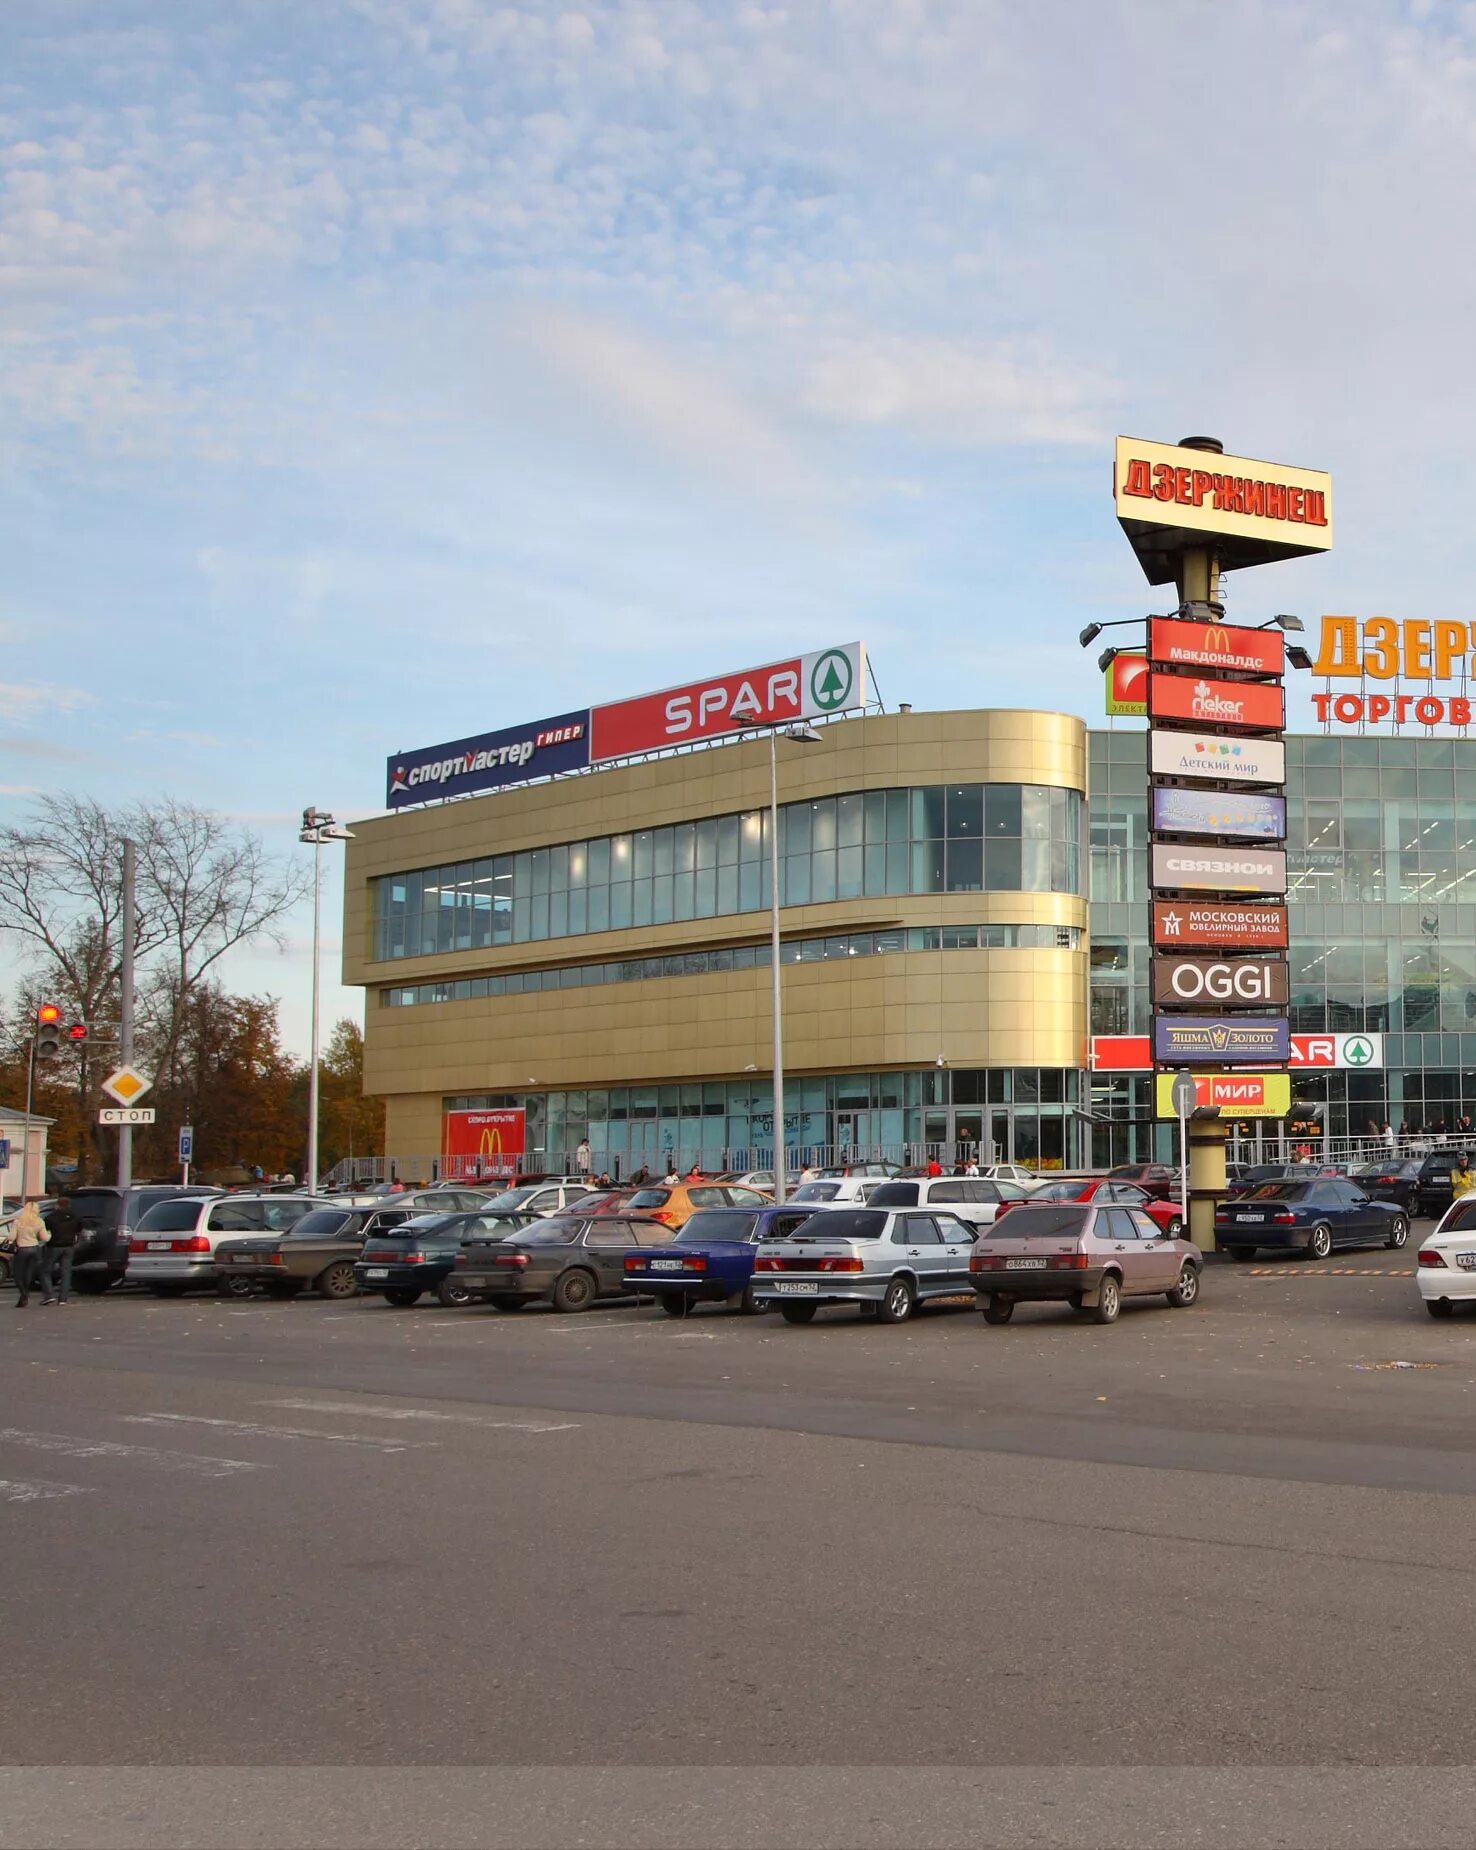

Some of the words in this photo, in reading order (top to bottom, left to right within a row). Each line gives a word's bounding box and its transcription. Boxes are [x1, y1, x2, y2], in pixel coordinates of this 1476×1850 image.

[1123, 459, 1328, 526] ДЗЕРЖИНЕЦ
[1170, 647, 1264, 669] Макдоналдс
[665, 670, 798, 734] SPAR
[1112, 704, 1145, 714] ЭЛЕКТ
[1192, 694, 1244, 713] rieker
[537, 724, 583, 746] ГИПЕР
[1179, 755, 1229, 772] Детский
[1234, 761, 1258, 776] мир
[1189, 911, 1280, 924] МОСКОВСКИЙ
[1189, 923, 1248, 932] ЮВЕЛИРНЫЙ
[1250, 924, 1281, 933] ЗАВОД
[1171, 963, 1271, 999] OGGI
[1172, 1032, 1209, 1043] ЯШМА
[1231, 1032, 1274, 1043] ЗОЛОТО
[1215, 1084, 1262, 1098] МИР
[104, 1110, 151, 1121] СТОП
